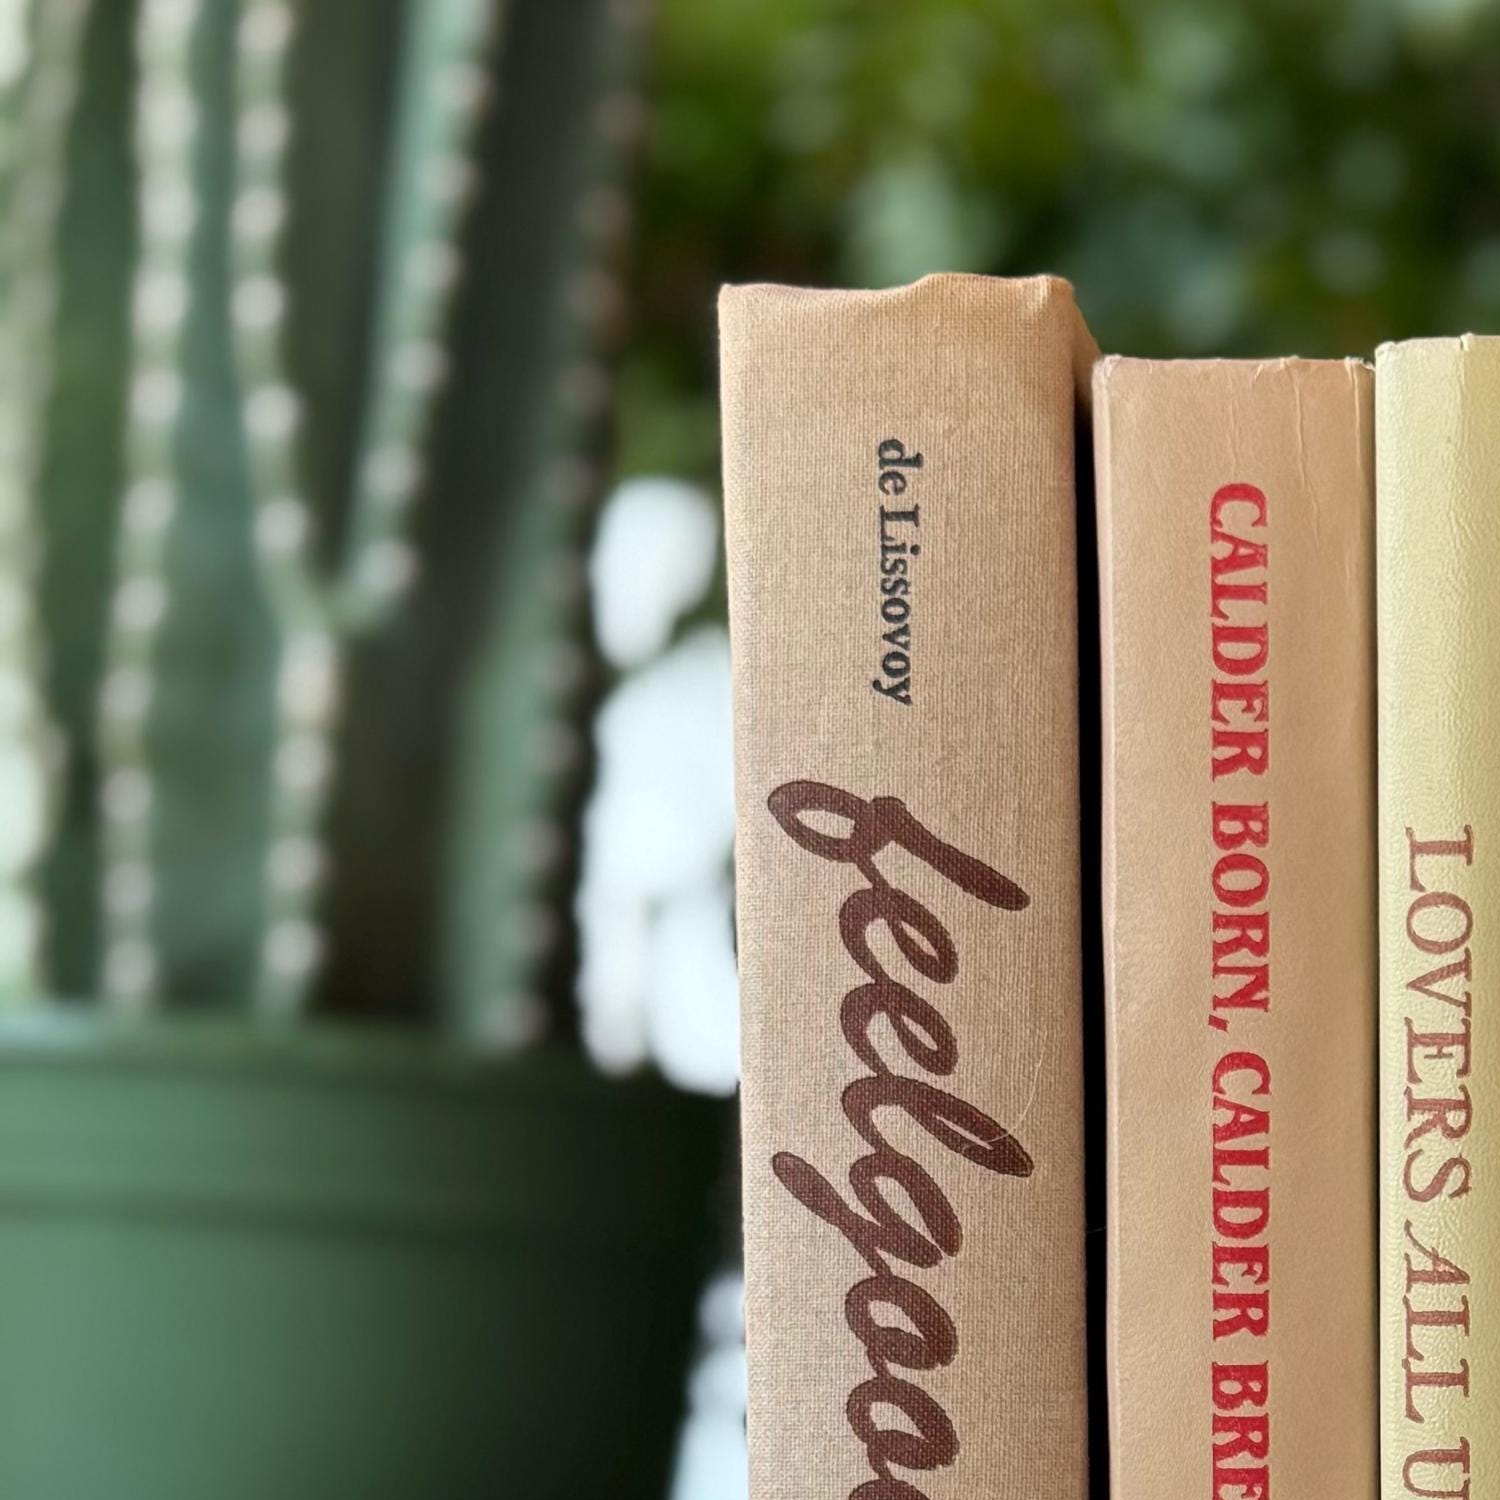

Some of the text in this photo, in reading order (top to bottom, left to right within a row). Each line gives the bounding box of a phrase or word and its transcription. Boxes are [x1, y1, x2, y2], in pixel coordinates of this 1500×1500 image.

[872, 438, 923, 705] de Lissovoy
[1209, 483, 1268, 781] CALDER
[1209, 801, 1269, 1031] BORN,
[1403, 824, 1474, 1204] LOVERS
[1211, 1051, 1269, 1338] CALDER
[1402, 1220, 1471, 1424] ALL
